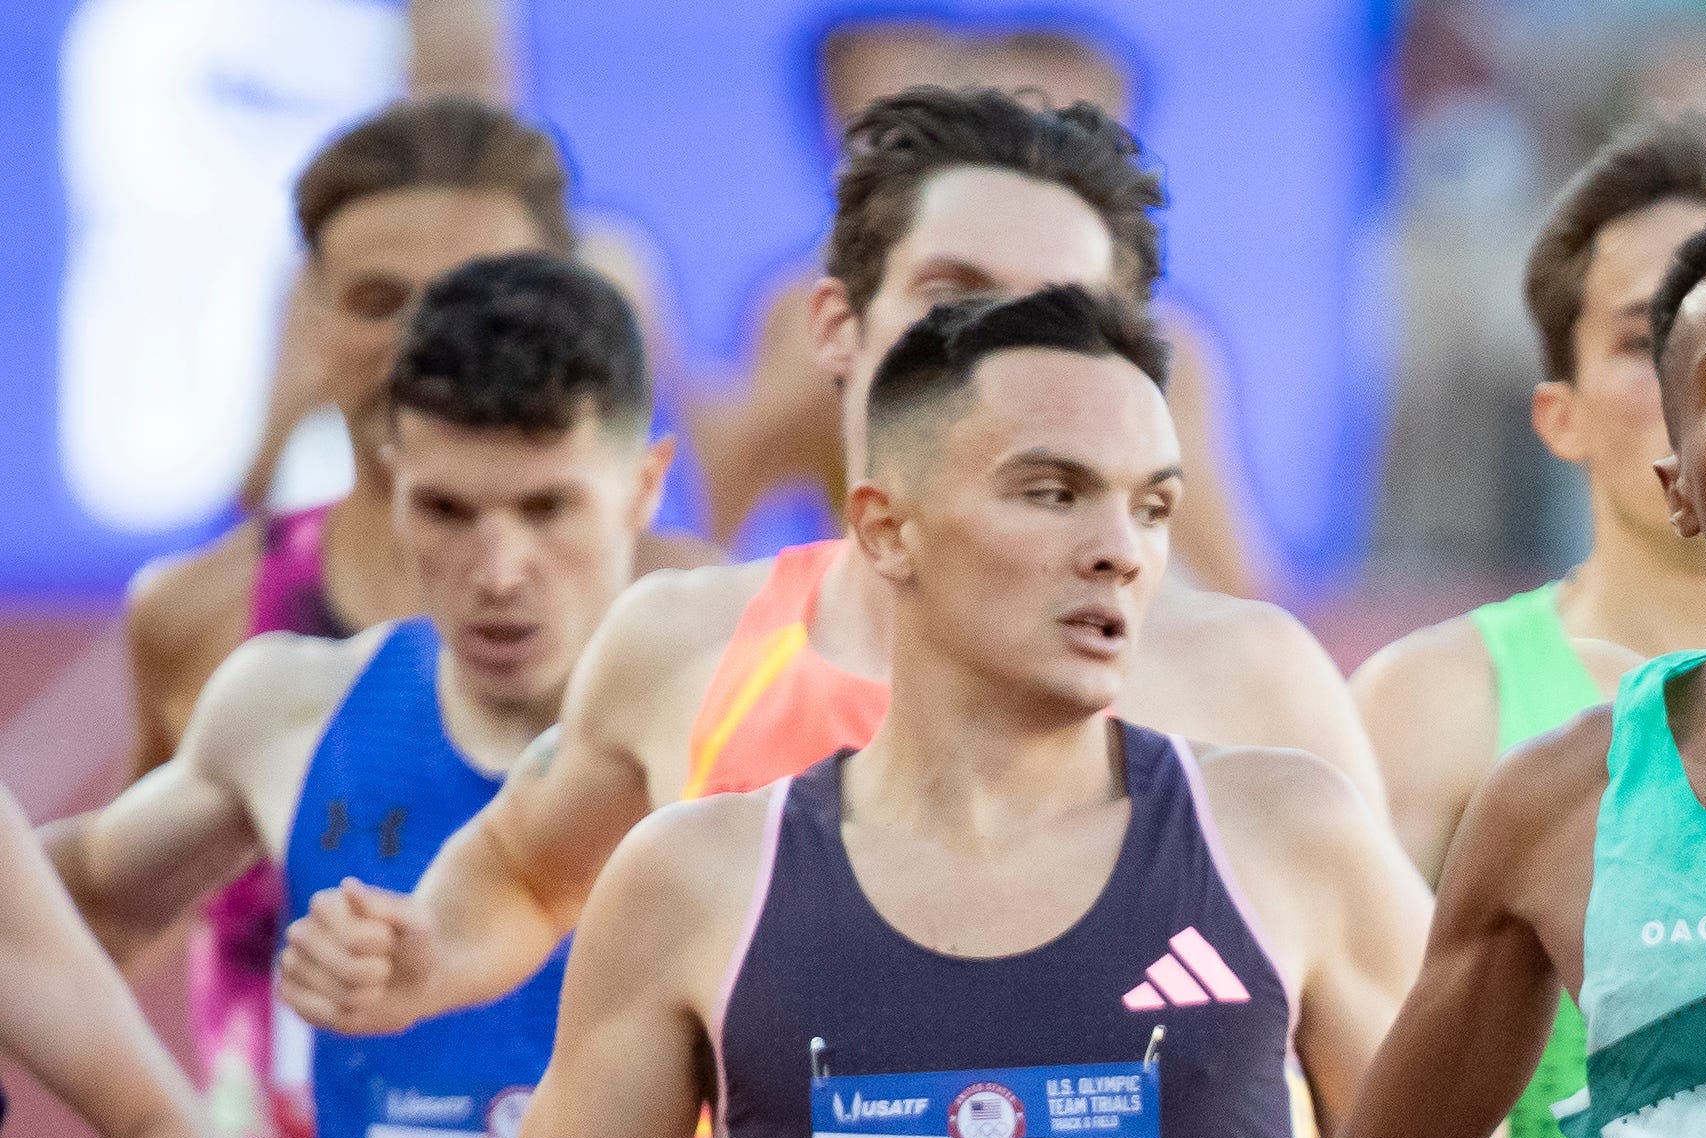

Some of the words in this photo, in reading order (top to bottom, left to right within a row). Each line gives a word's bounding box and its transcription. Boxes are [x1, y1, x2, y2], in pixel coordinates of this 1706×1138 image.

[1046, 1078, 1076, 1096] U.S.
[1078, 1075, 1140, 1095] OLYMPIC
[861, 1098, 929, 1118] USATF
[1048, 1096, 1088, 1115] TEAM
[1090, 1094, 1142, 1114] TRIALS
